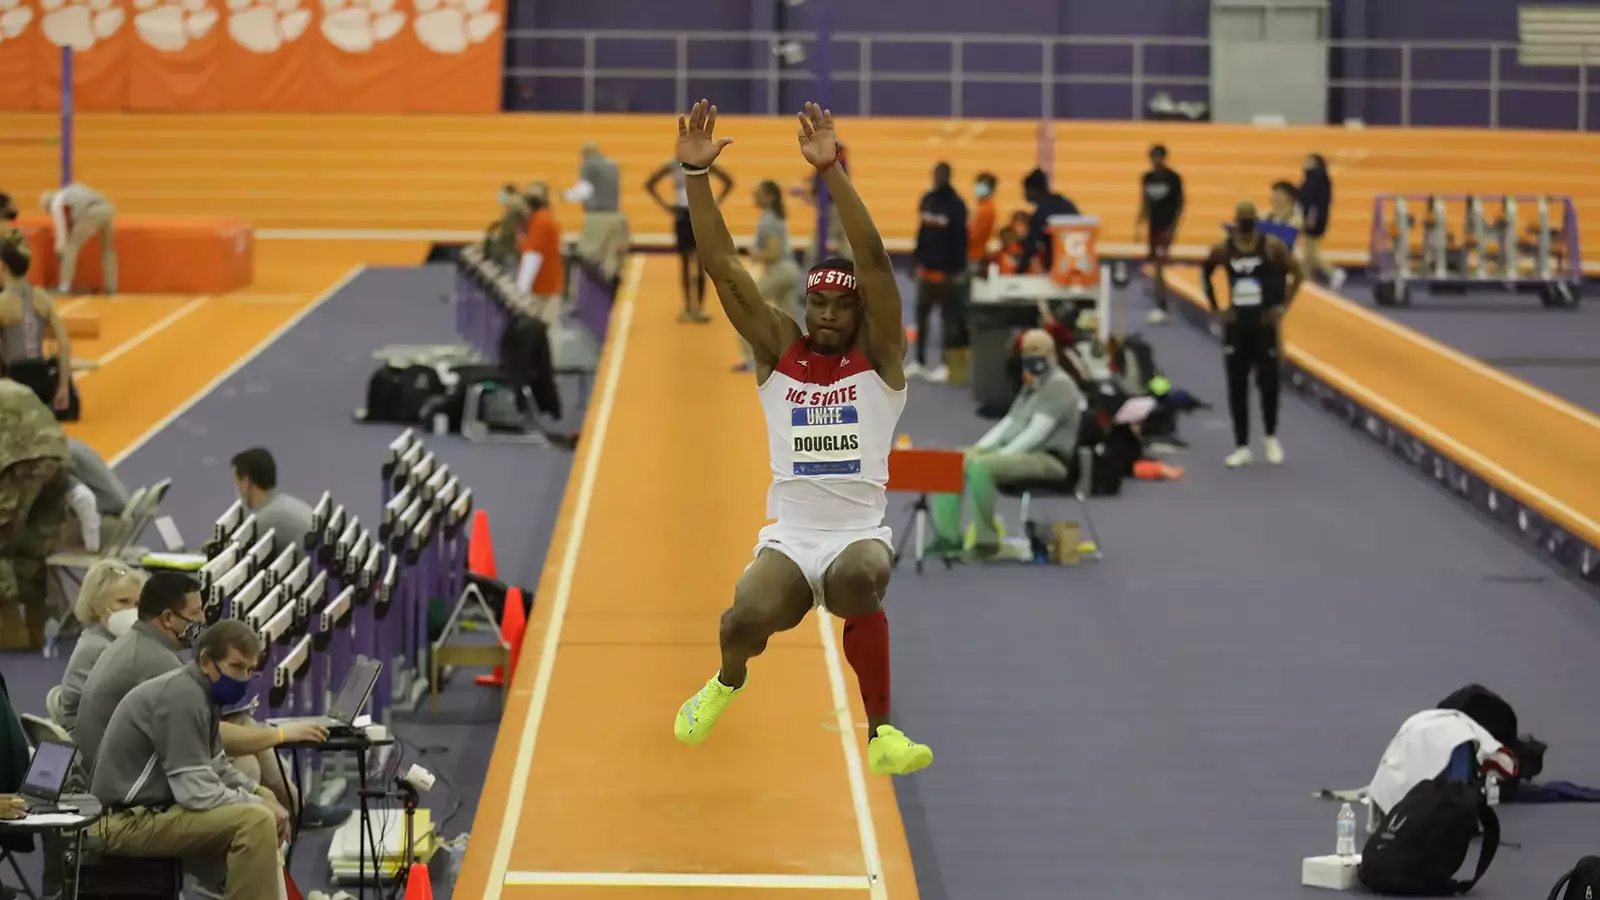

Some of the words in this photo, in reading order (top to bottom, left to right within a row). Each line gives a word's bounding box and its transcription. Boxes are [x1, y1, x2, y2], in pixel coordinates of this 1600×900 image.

[807, 271, 823, 288] NC
[785, 387, 807, 405] NC
[809, 385, 857, 406] STATE
[807, 407, 843, 425] UNITE
[794, 434, 859, 452] DOUGLAS
